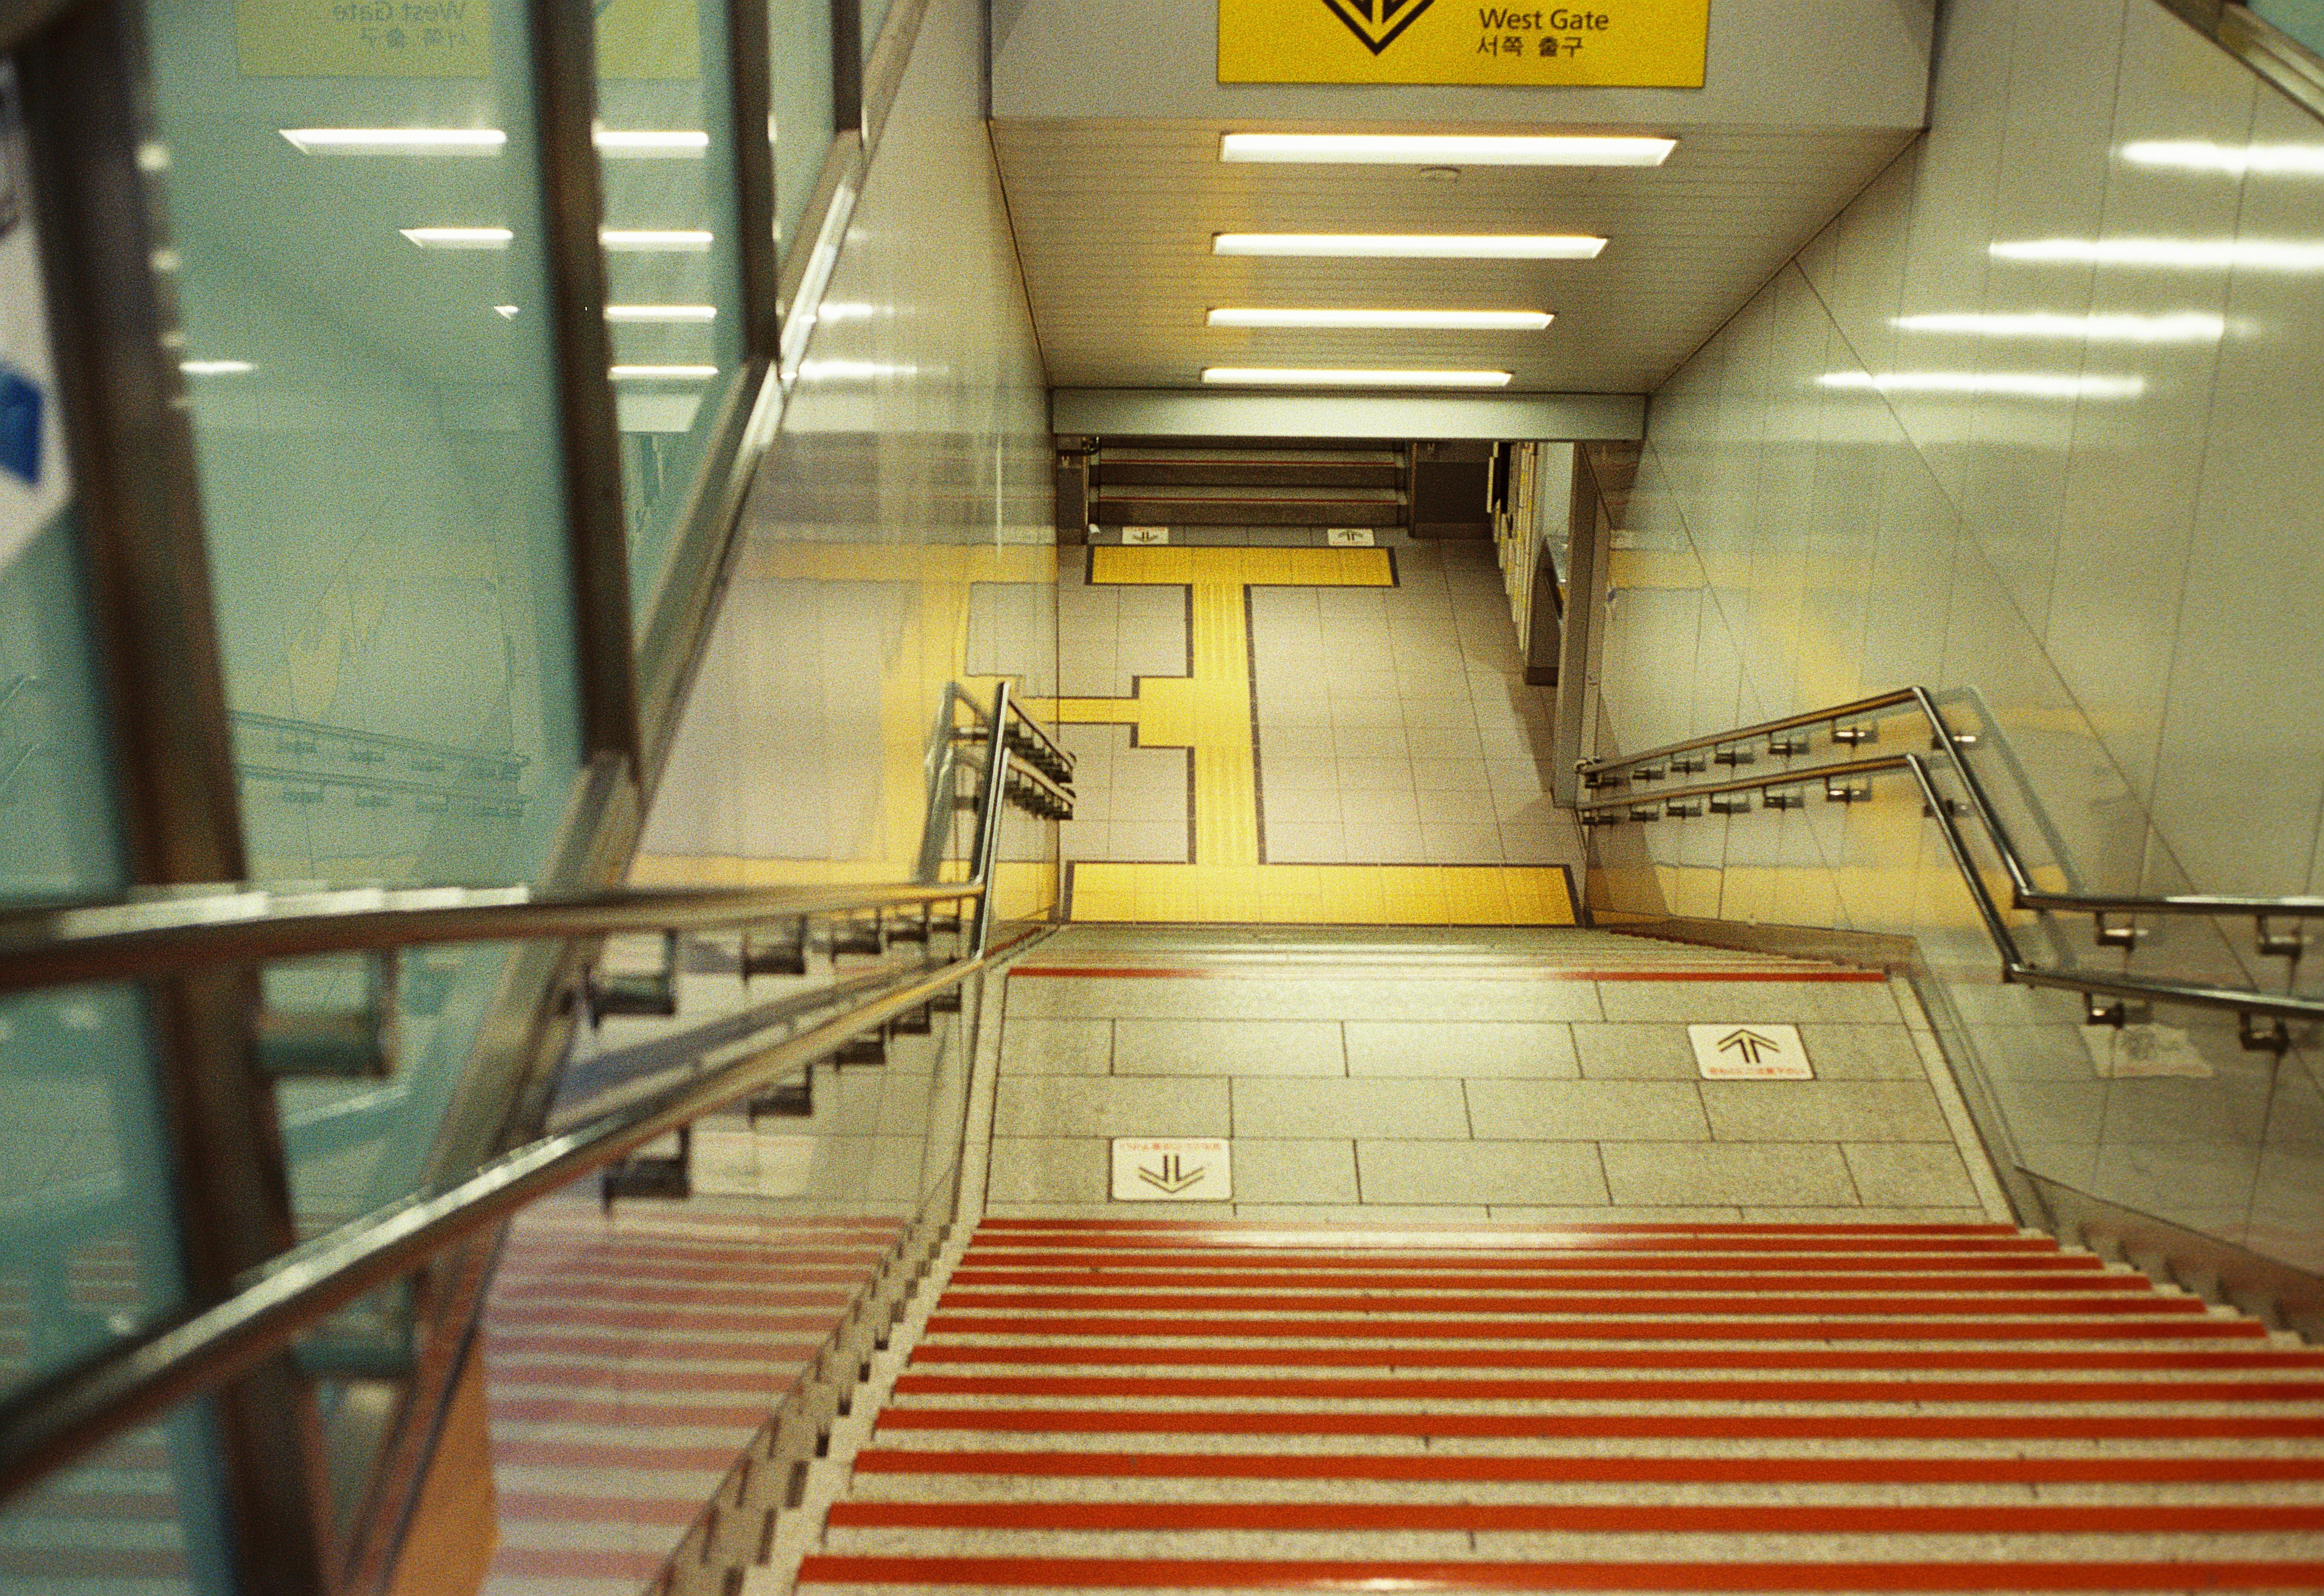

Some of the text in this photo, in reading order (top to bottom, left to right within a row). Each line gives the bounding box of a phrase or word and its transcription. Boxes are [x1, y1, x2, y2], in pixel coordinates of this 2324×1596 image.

[1479, 8, 1609, 30] West Gate
[1476, 35, 1583, 57] 서쪽 출구
